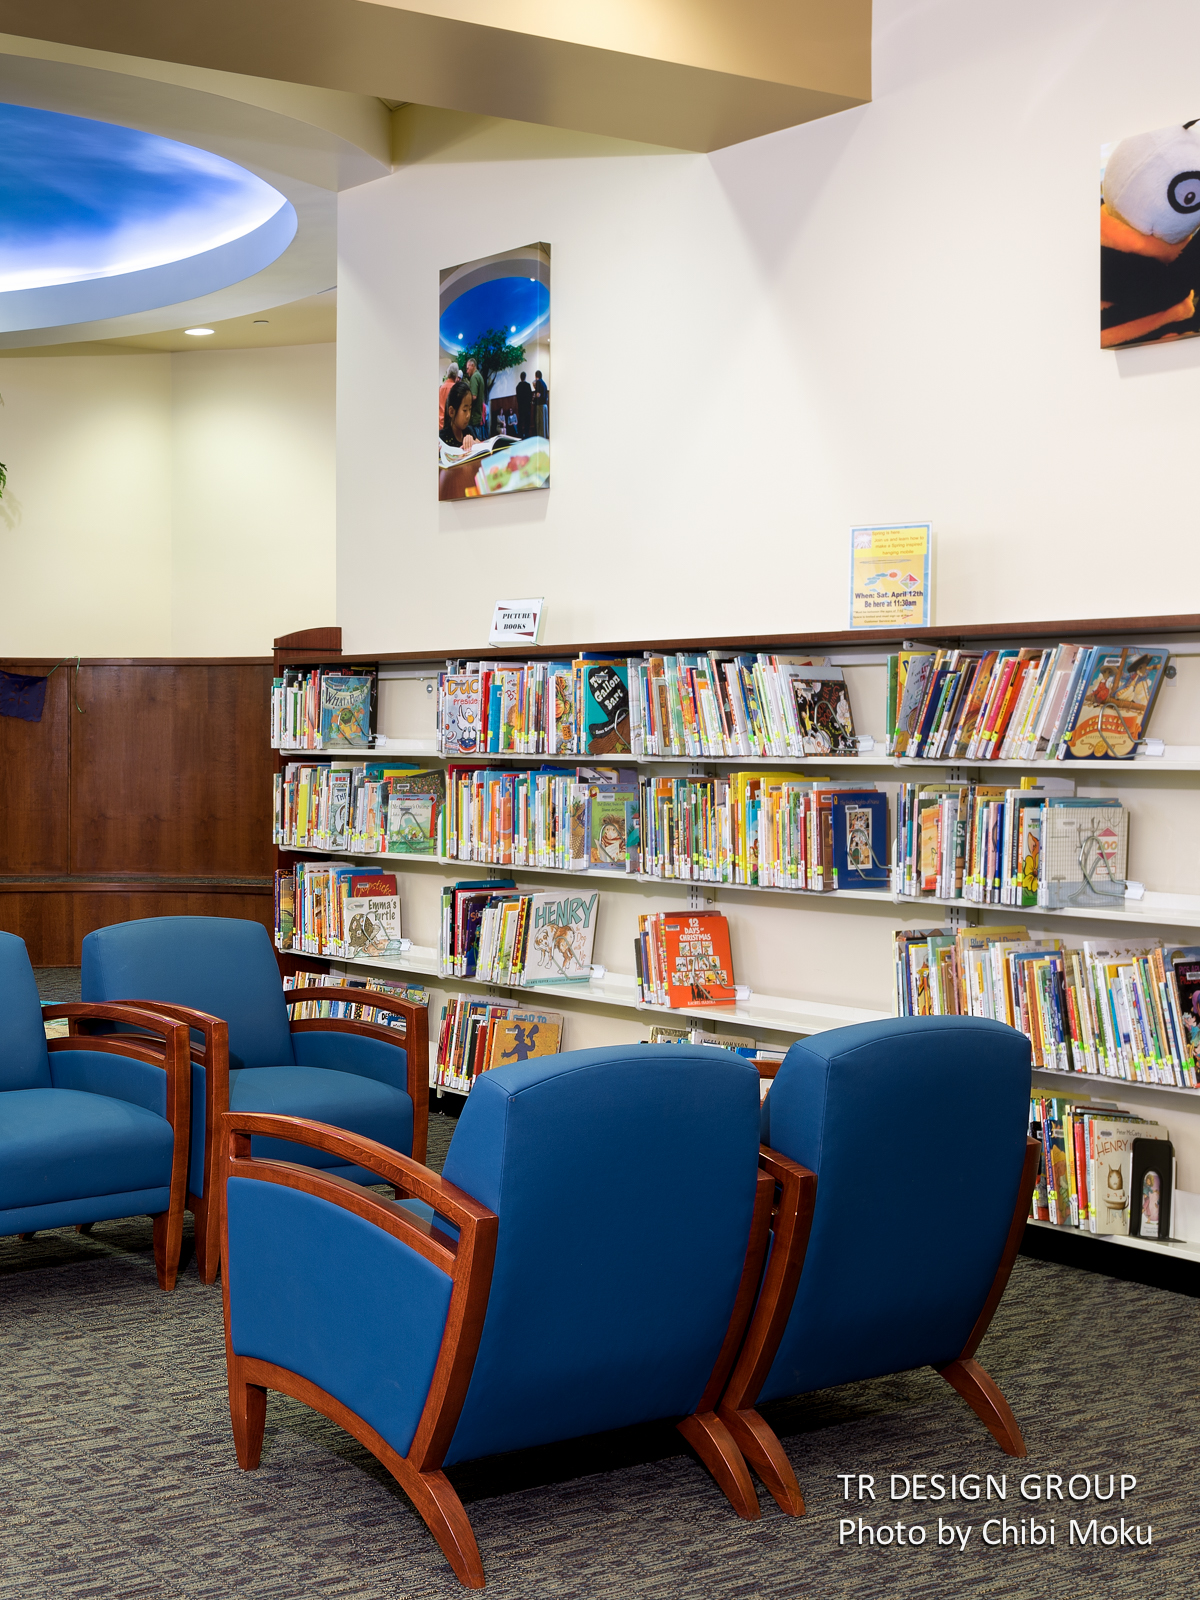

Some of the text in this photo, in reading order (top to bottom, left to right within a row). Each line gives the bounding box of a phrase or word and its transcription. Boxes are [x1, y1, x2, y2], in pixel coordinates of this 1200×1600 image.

[891, 591, 907, 599] April
[594, 675, 620, 702] Gallon
[604, 689, 623, 710] Bart
[369, 899, 397, 910] Emma's
[374, 910, 395, 921] Turtle
[535, 893, 597, 928] HENRY
[689, 918, 699, 927] 12
[679, 934, 711, 942] CHRISTMAS
[1126, 1129, 1142, 1138] McCarty
[1096, 1140, 1128, 1158] HENRY
